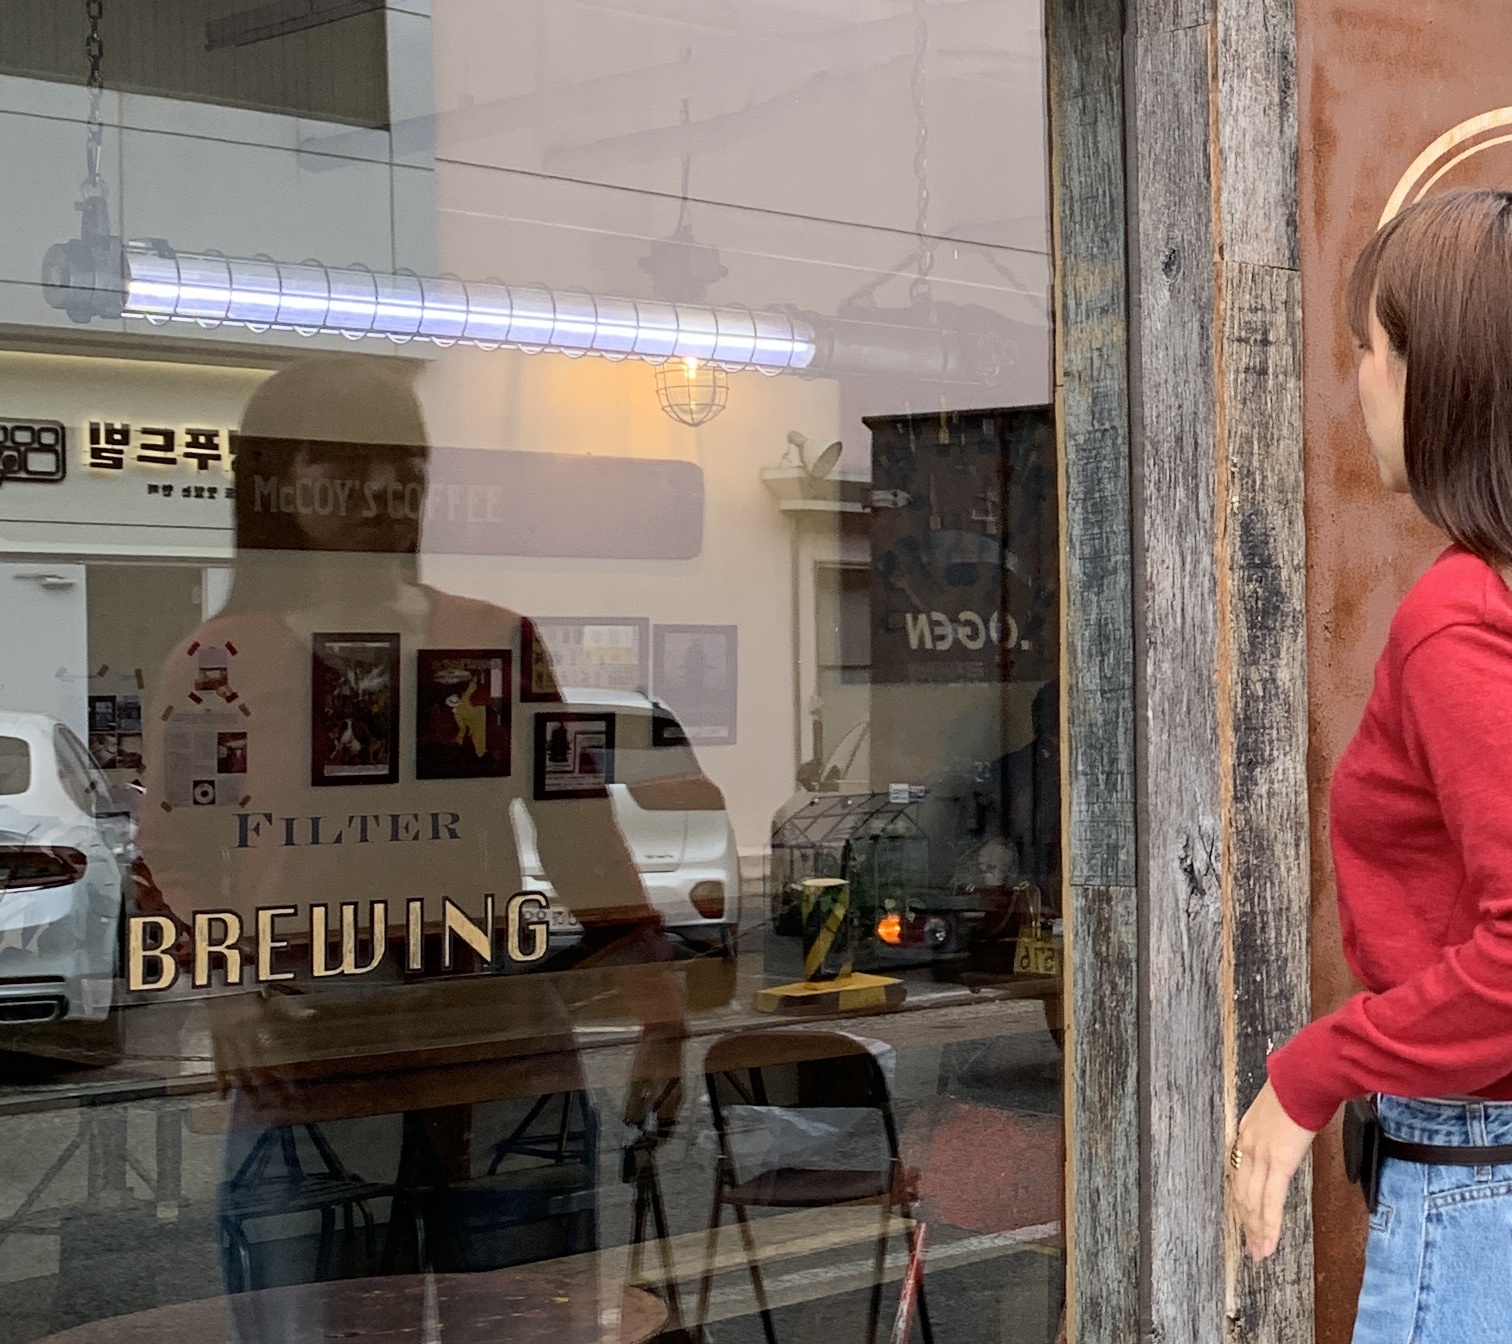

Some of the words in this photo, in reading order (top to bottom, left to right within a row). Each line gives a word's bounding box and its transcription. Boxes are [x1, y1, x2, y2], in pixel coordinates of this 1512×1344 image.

[253, 474, 378, 518] McCOY'S
[232, 811, 462, 849] FILTER
[126, 890, 551, 993] BREWING
